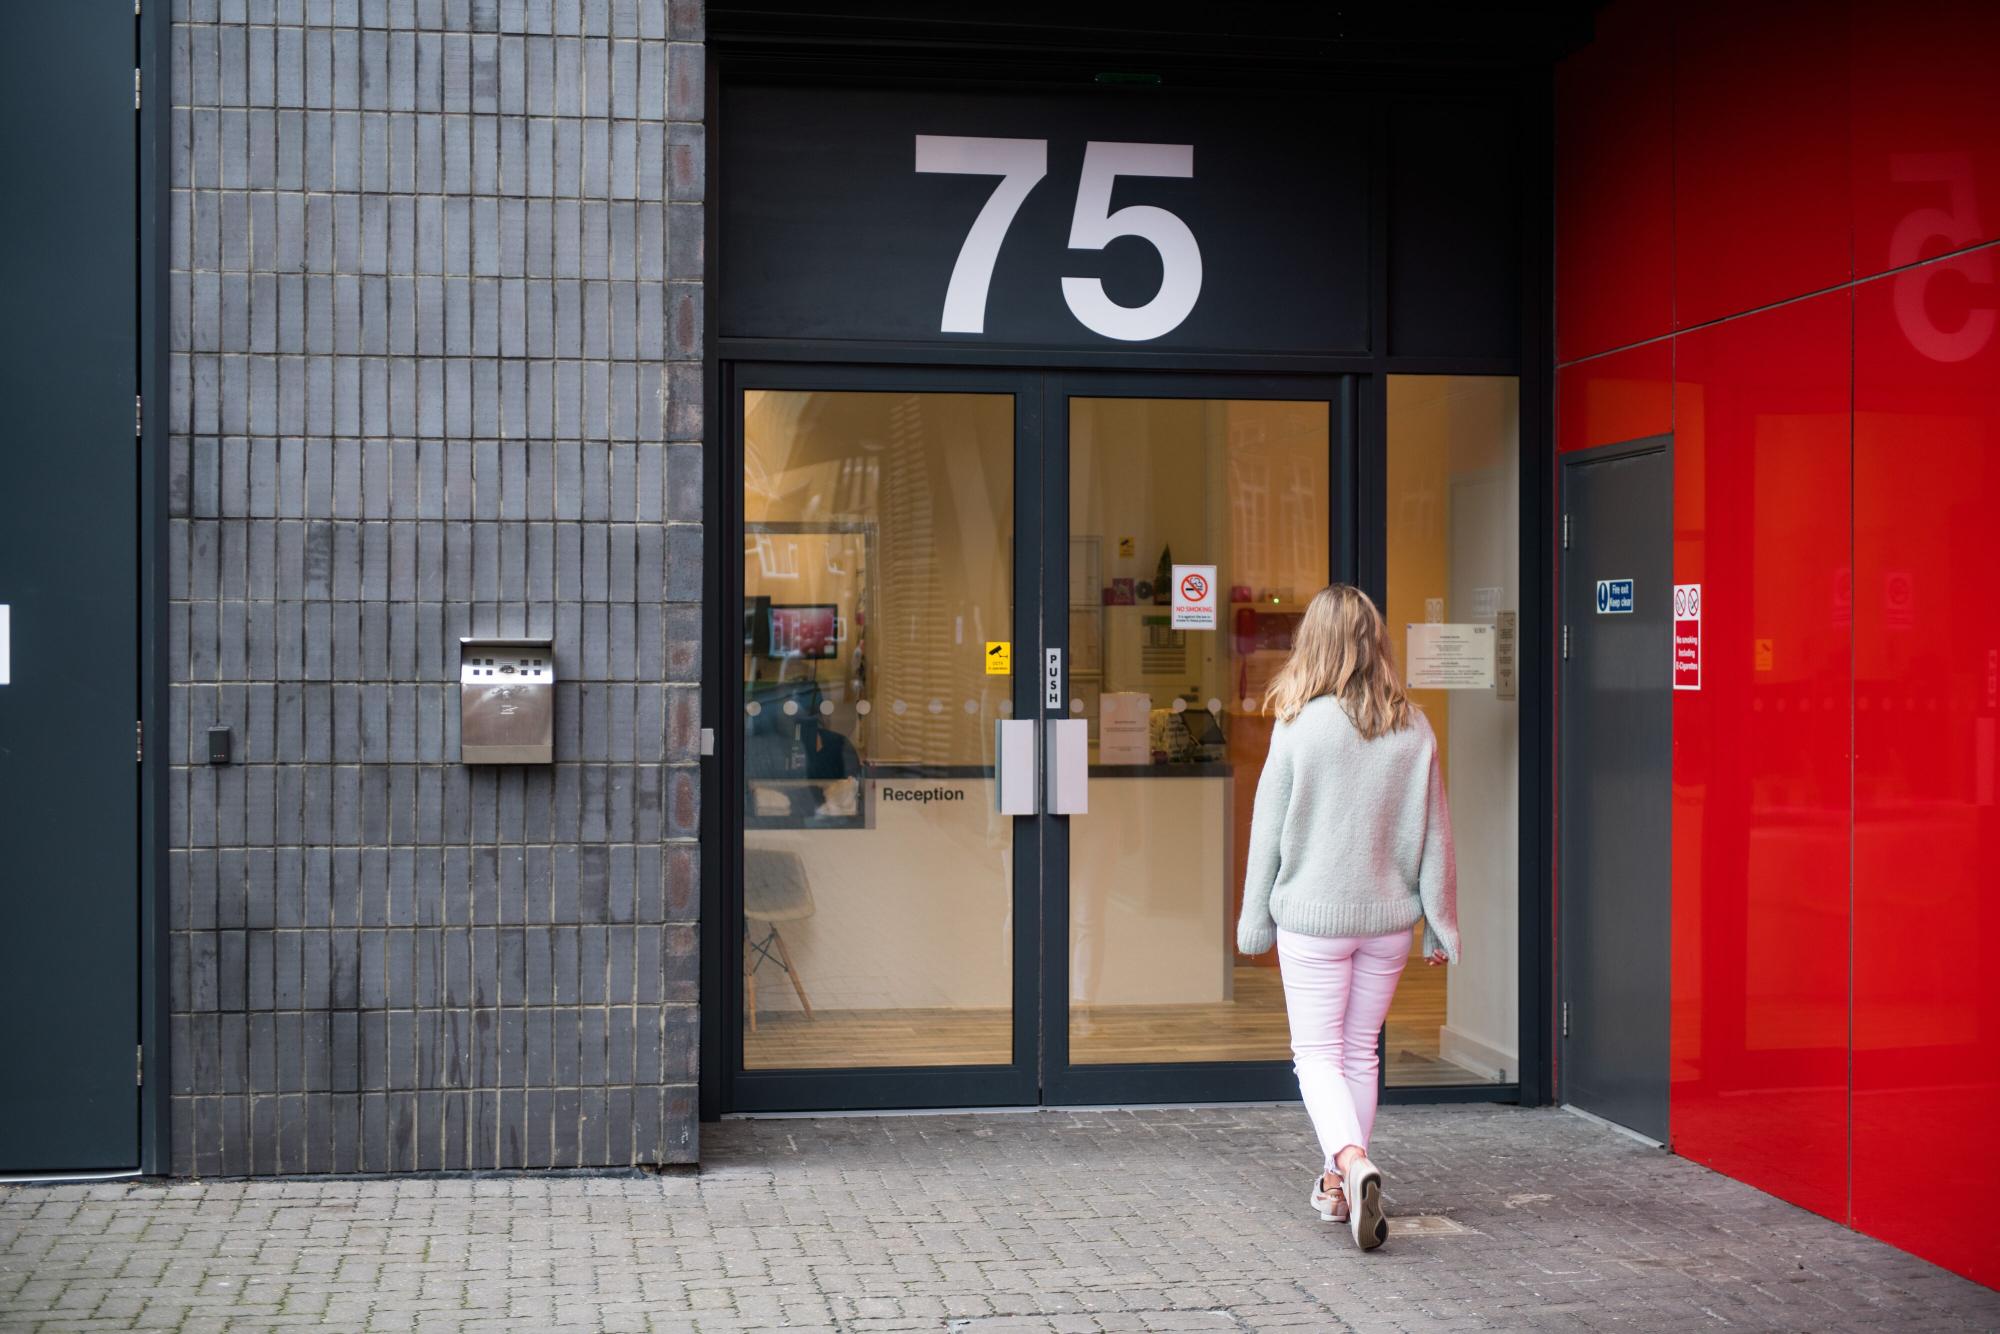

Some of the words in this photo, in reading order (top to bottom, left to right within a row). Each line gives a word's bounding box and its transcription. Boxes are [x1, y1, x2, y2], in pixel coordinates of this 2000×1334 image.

[915, 135, 1203, 341] 75
[1612, 584, 1620, 594] Fire
[1621, 583, 1629, 594] exit
[1610, 597, 1620, 608] Keep
[1621, 597, 1631, 607] clear
[1676, 635, 1682, 644] No
[1682, 635, 1697, 646] smoking
[1049, 654, 1058, 703] PUSH
[883, 787, 964, 804] Reception
